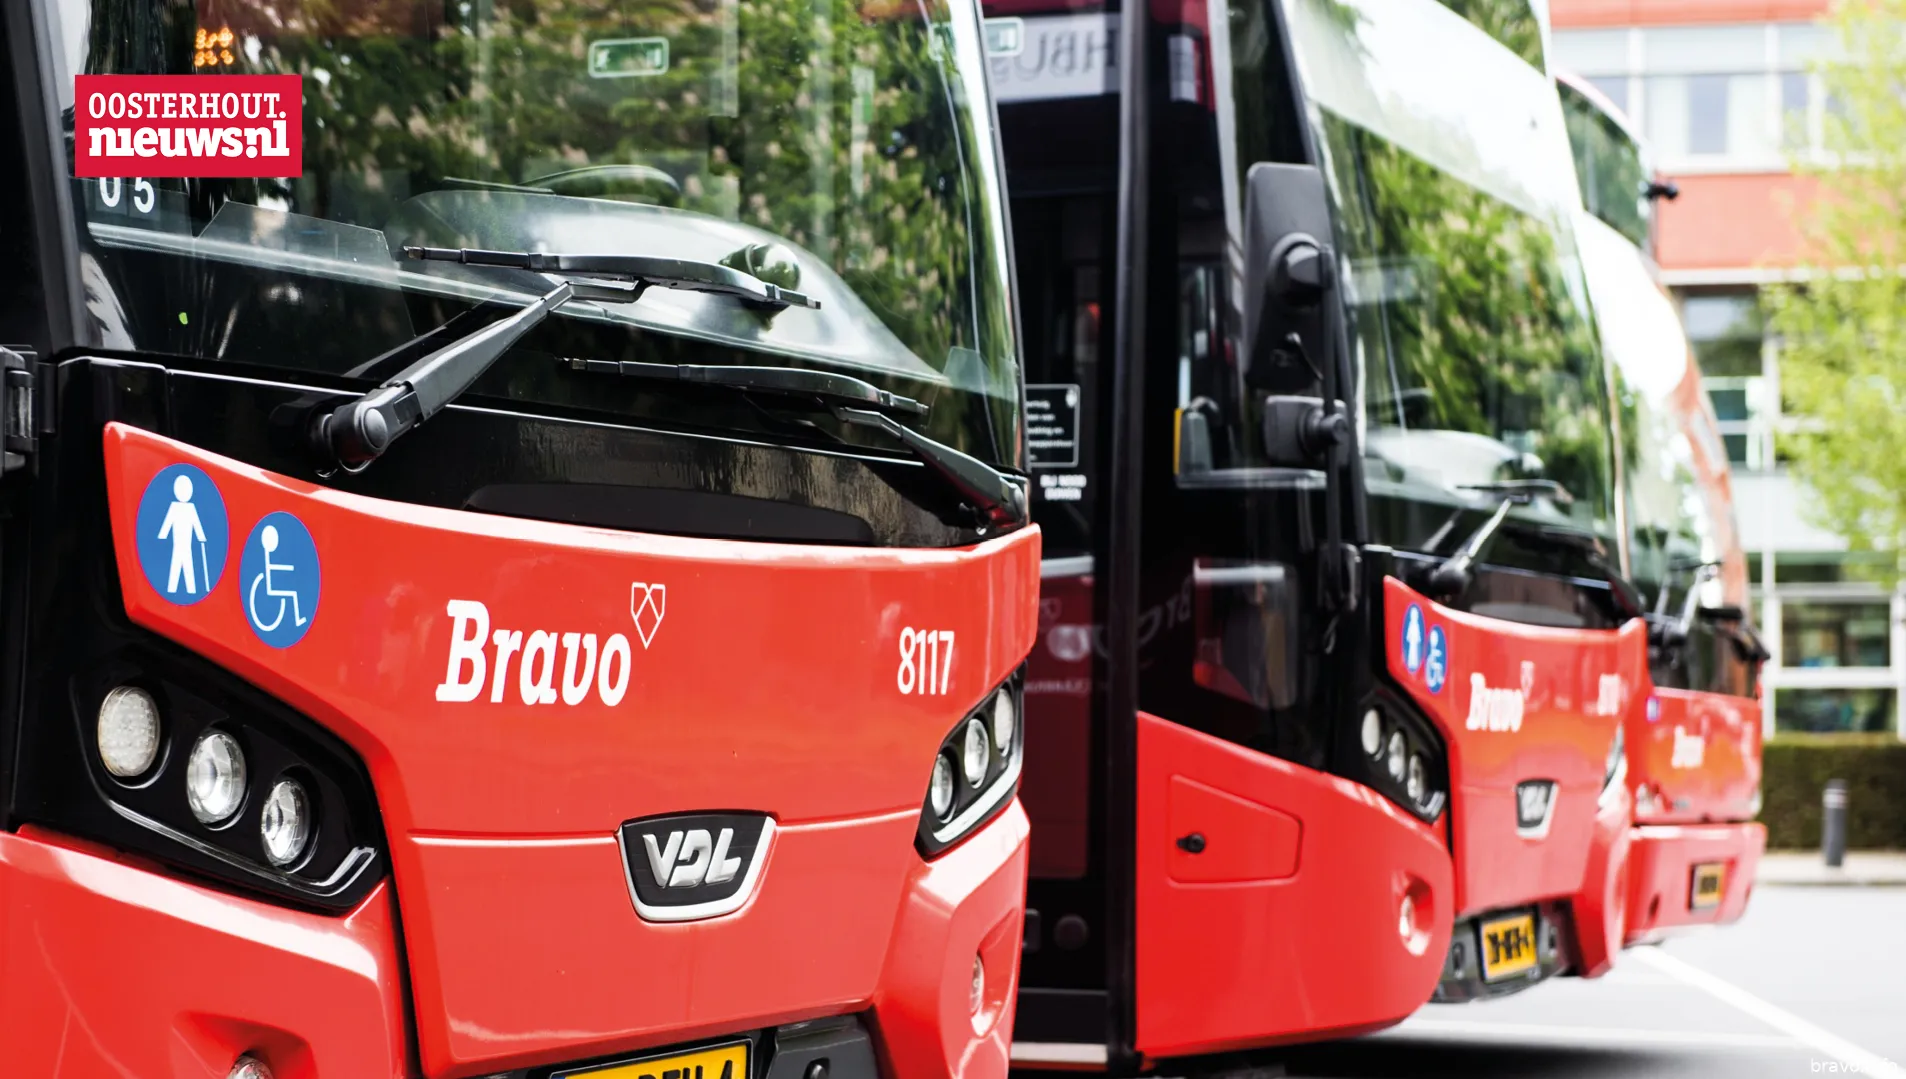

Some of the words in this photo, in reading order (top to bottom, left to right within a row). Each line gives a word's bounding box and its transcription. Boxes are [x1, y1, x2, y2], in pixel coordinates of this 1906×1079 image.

[435, 599, 633, 707] Bravo
[896, 626, 956, 696] 8117
[642, 828, 742, 889] VDL
